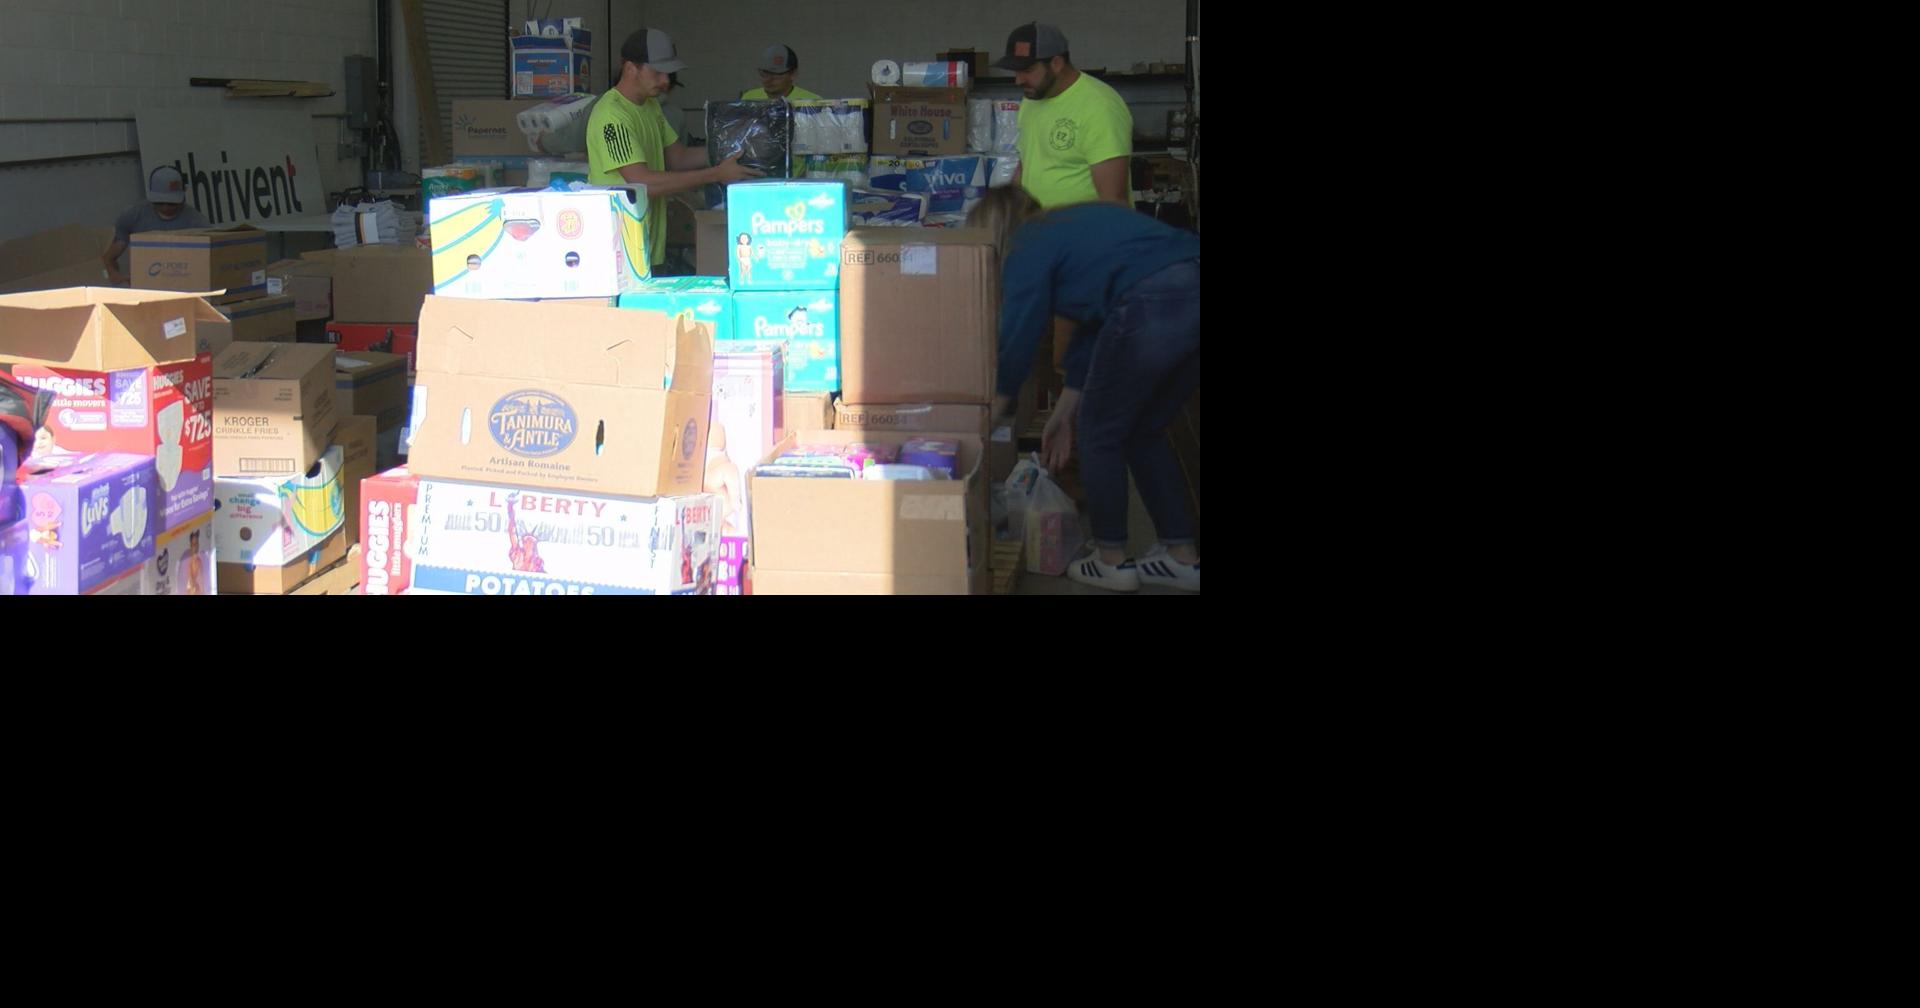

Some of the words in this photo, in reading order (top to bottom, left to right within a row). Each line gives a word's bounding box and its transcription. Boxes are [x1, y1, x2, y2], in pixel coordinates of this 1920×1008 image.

[920, 105, 952, 117] House
[752, 211, 825, 238] Pampers
[848, 252, 872, 263] REF
[755, 316, 824, 340] Pampers
[153, 370, 183, 391] HUGGIES
[184, 377, 211, 404] SAVE
[184, 411, 211, 443] $725
[224, 416, 269, 427] KROGER
[491, 410, 573, 435] TANIMURA
[842, 414, 865, 424] REF
[505, 428, 560, 450] ANTLE
[489, 456, 525, 467] Artisan
[528, 459, 571, 472] Romaine
[419, 483, 433, 556] PREMIUM
[475, 511, 502, 533] 50
[366, 500, 390, 595] HUGGIES
[587, 525, 615, 548] 50
